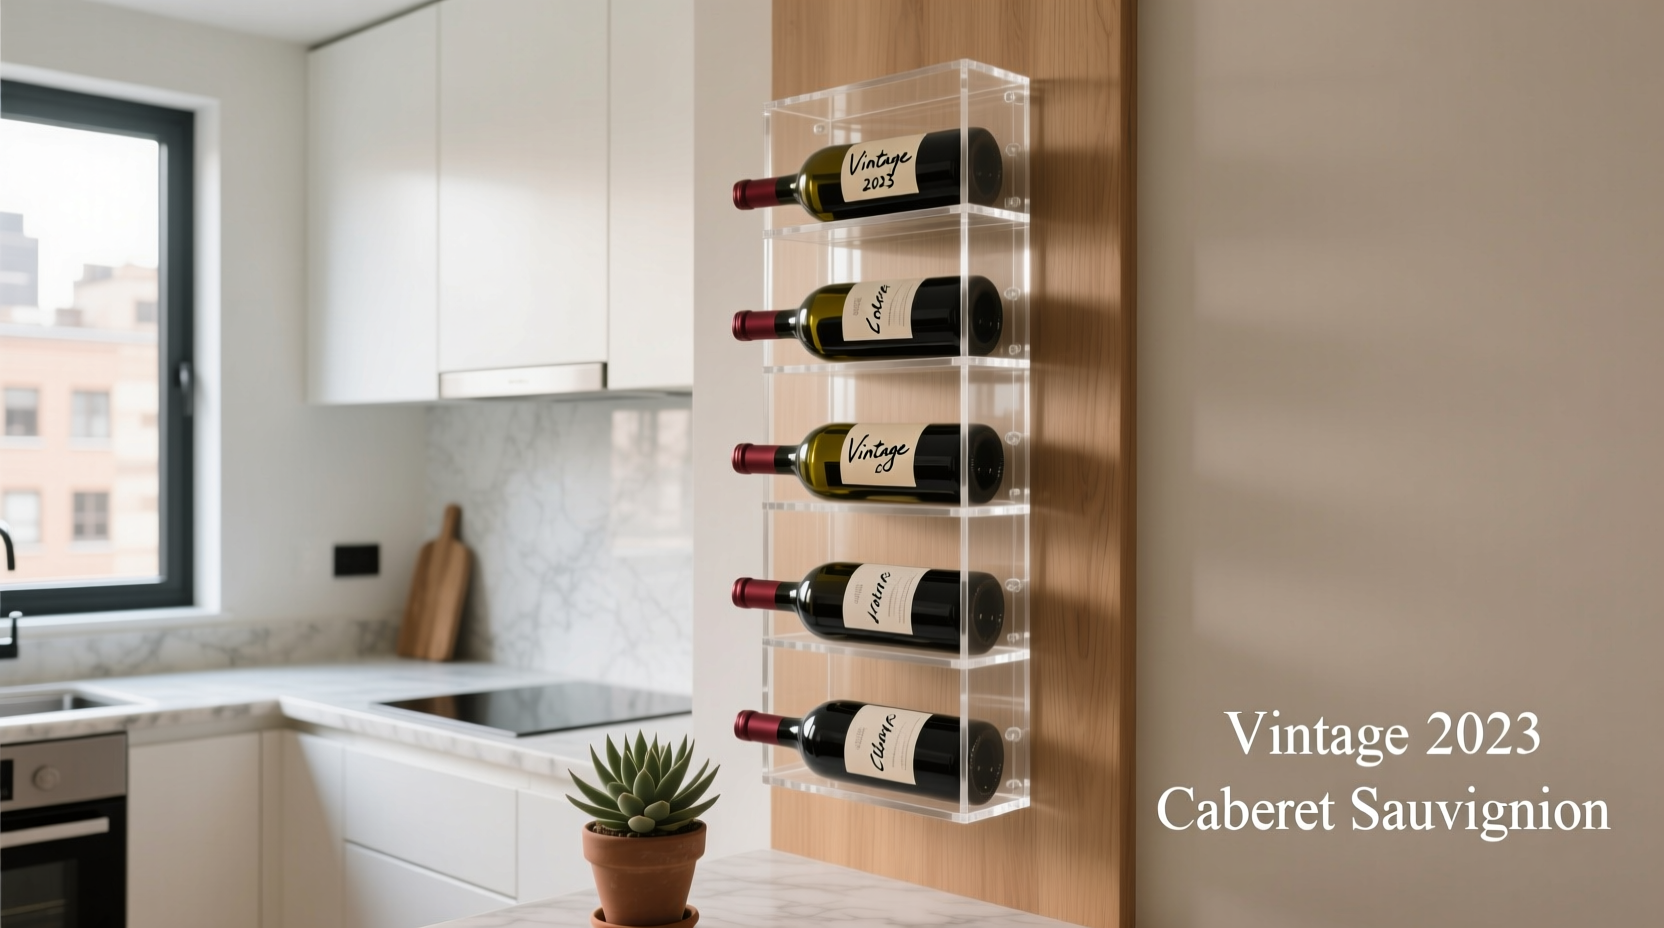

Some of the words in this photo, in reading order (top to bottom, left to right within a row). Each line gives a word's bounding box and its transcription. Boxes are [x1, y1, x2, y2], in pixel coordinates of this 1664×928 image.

[849, 150, 913, 176] Vintage
[862, 173, 895, 192] 2023
[848, 434, 911, 473] Vintage
